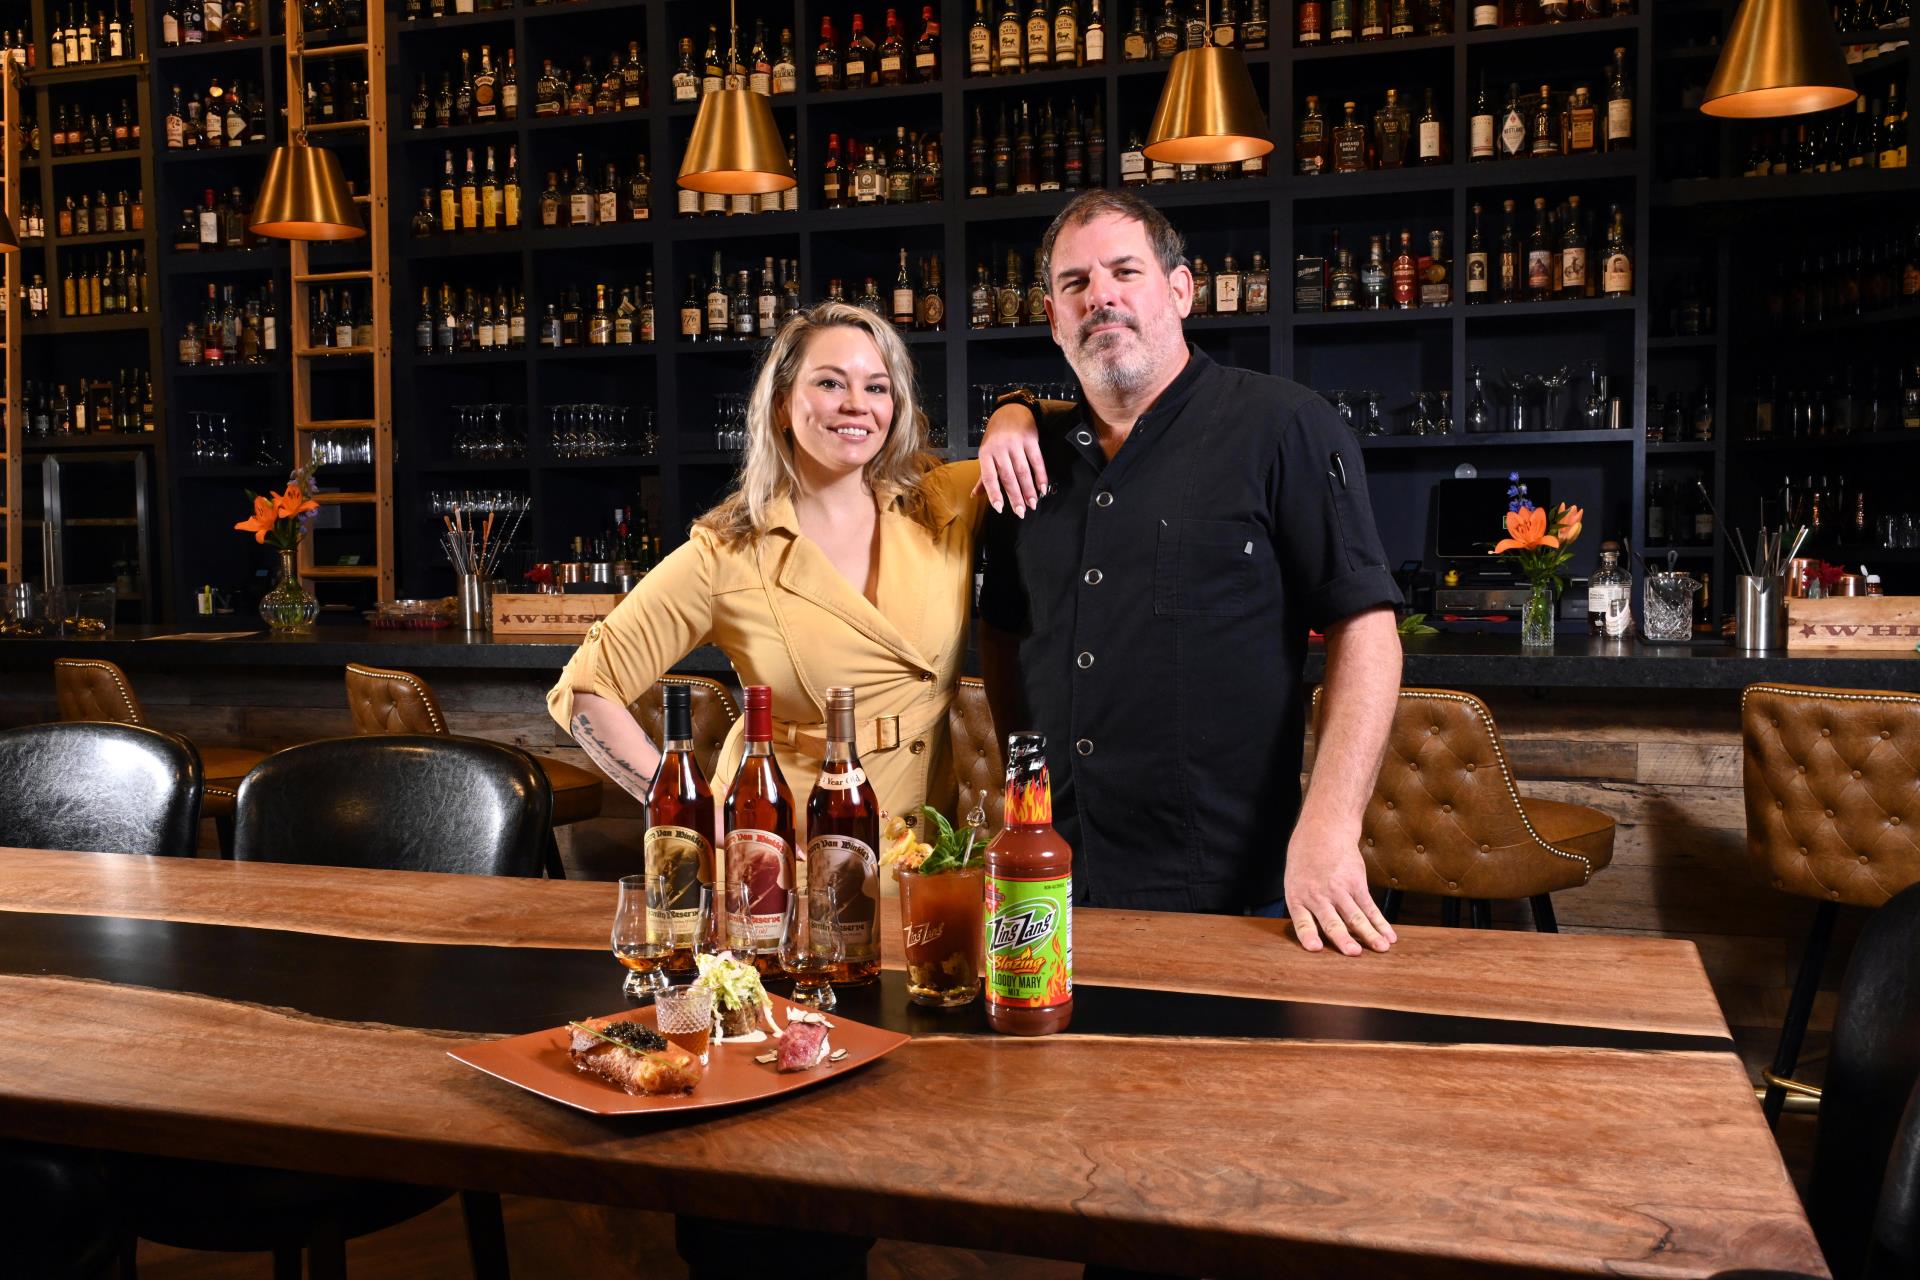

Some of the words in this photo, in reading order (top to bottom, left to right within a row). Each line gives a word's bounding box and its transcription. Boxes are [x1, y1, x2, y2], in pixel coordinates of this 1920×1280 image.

[827, 778, 844, 786] Year
[821, 840, 838, 848] Van
[985, 914, 1020, 954] Zing
[1006, 909, 1056, 950] Zang
[992, 955, 1047, 974] Blazing
[1019, 975, 1042, 989] MARY
[1008, 988, 1020, 996] MIX
